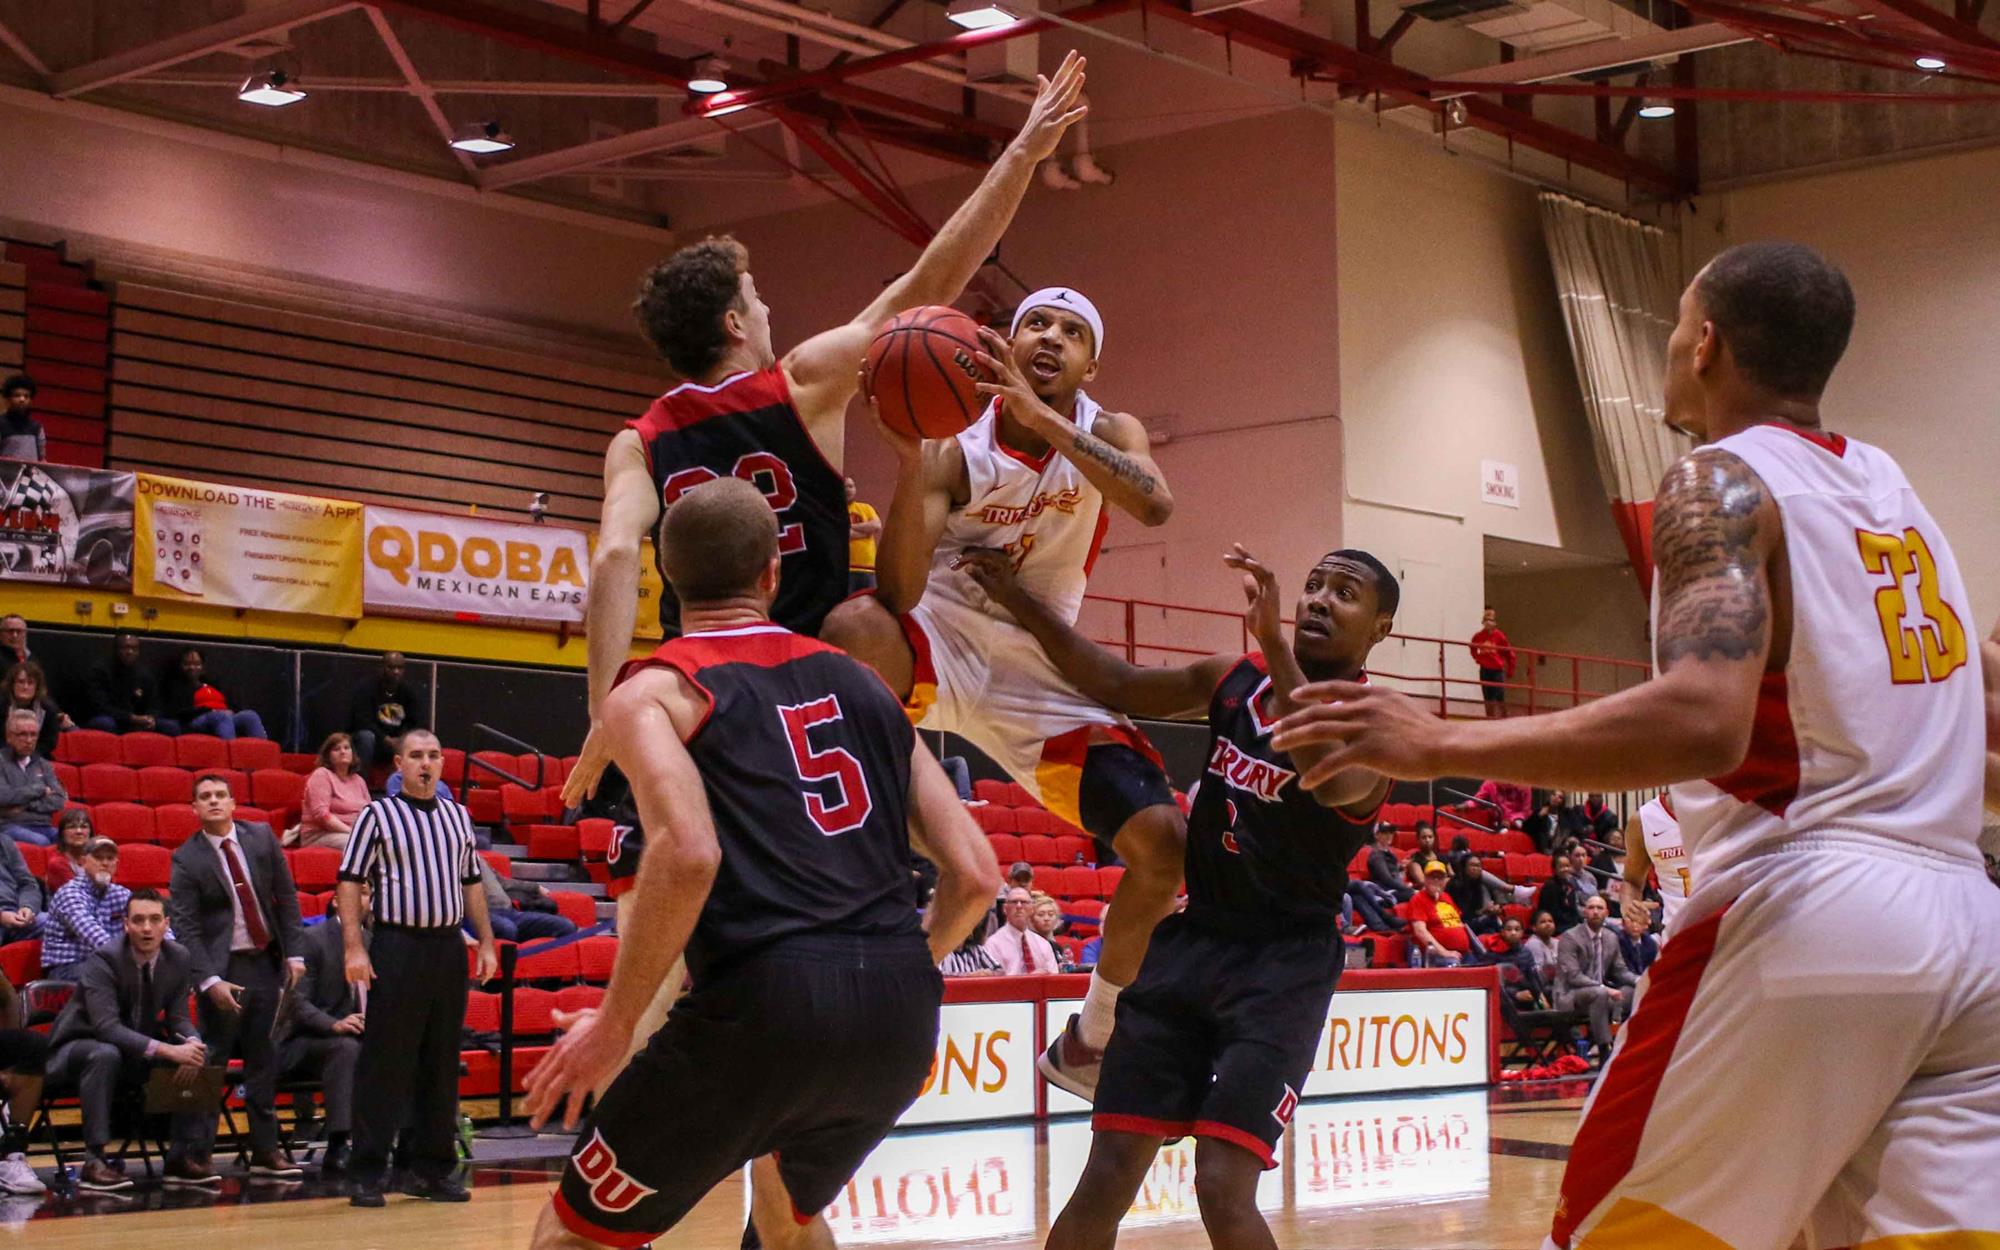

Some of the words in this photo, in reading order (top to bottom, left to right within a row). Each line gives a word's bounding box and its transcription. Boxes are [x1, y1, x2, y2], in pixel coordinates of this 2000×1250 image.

[137, 479, 240, 505] DOWNLOAD
[243, 494, 276, 510] THE
[322, 504, 361, 521] APP!
[1486, 482, 1515, 499] SMOKING
[1494, 469, 1504, 482] NO
[368, 525, 586, 587] QDOBA
[417, 576, 519, 599] MEXICAN
[531, 588, 582, 604] EATS
[1854, 526, 1968, 685] 23
[776, 693, 873, 837] 5
[1309, 1012, 1469, 1072] RITONS
[572, 1126, 659, 1213] DU
